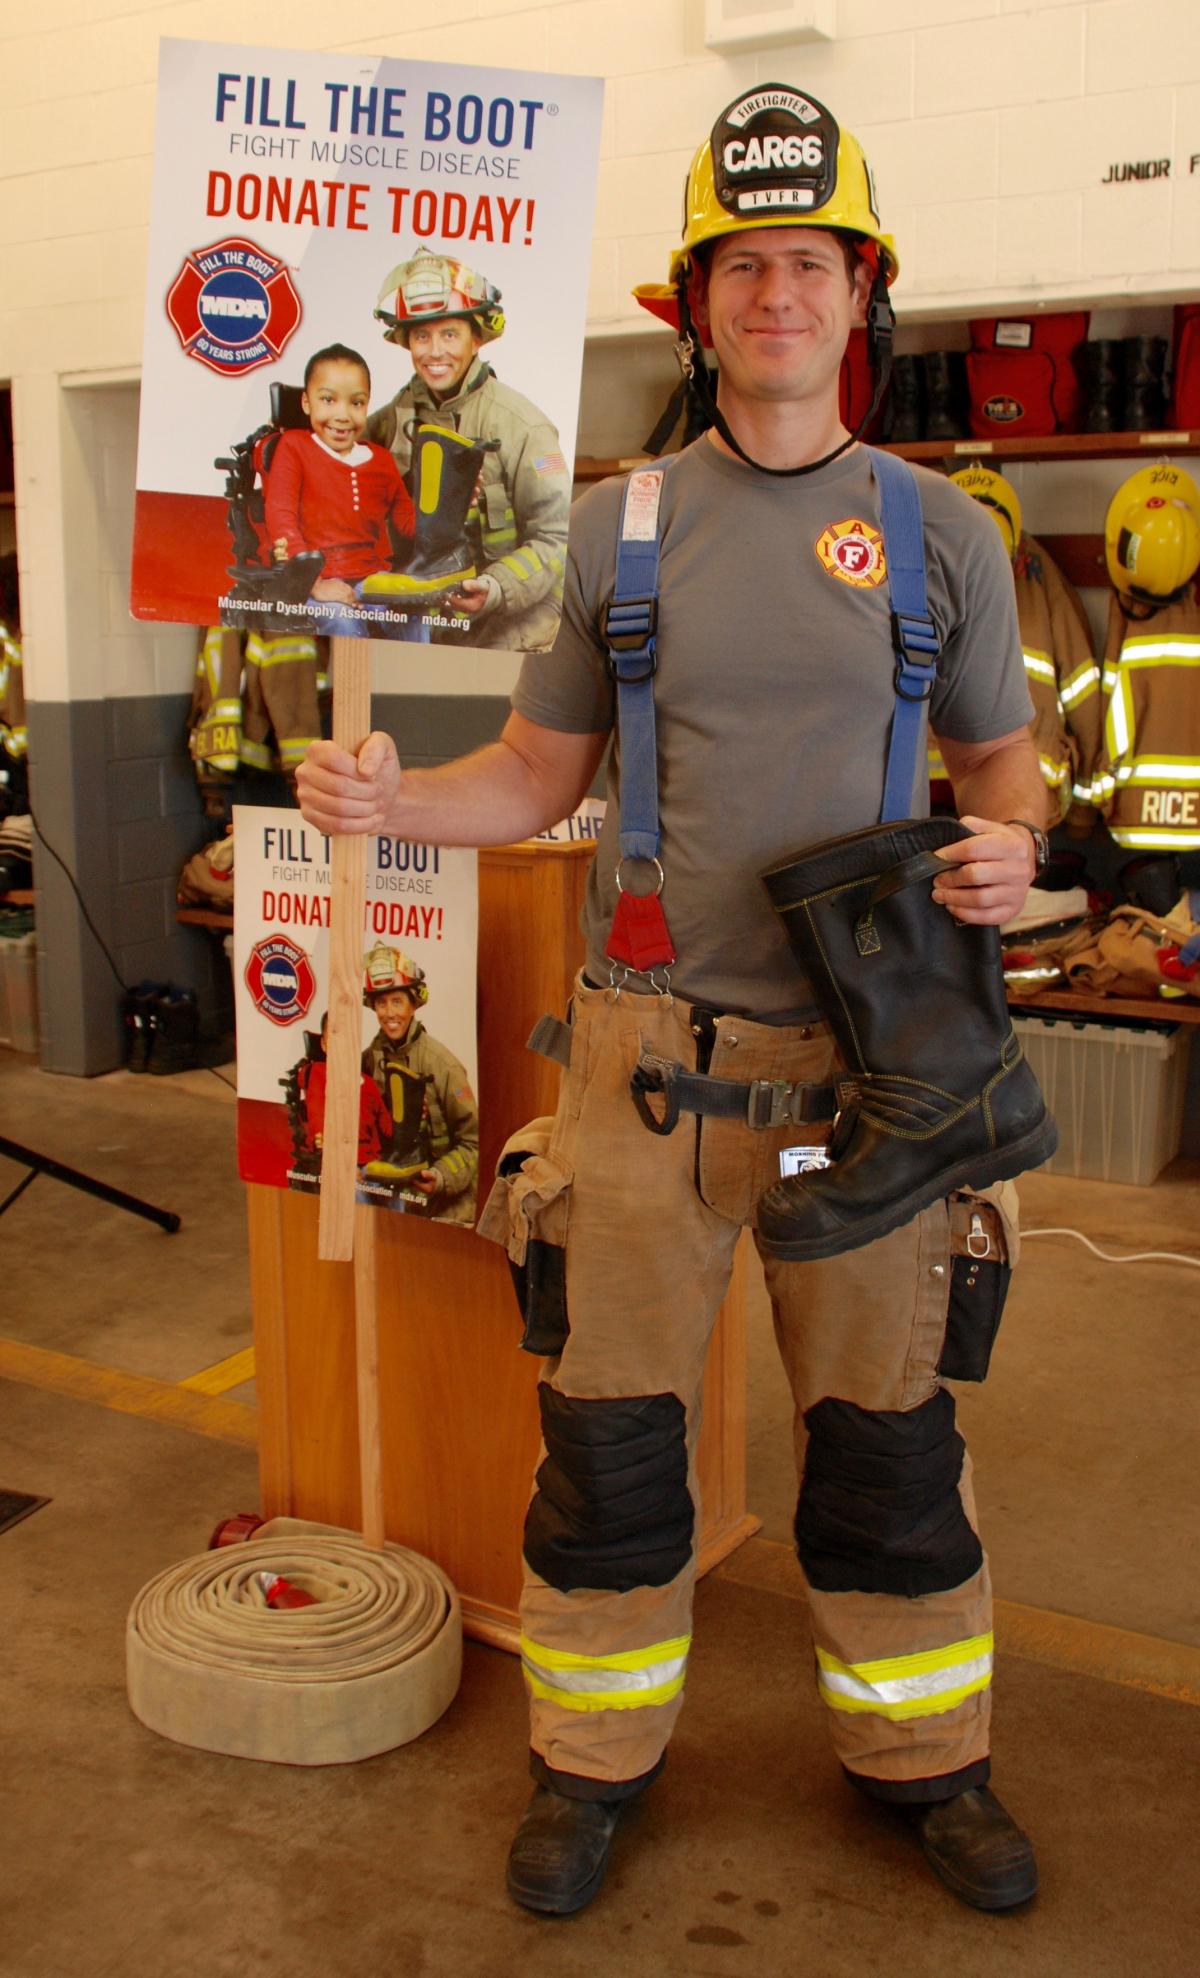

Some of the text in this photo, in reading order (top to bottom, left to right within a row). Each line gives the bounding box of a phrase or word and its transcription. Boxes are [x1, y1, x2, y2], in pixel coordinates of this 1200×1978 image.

[215, 73, 306, 129] FILL
[325, 82, 407, 138] THE
[737, 95, 808, 118] FIREFIGHTER
[229, 133, 520, 179] FIGHT MUSCLE DISEASE
[724, 135, 823, 173] CAR66
[1102, 159, 1171, 183] JUNIOR
[206, 170, 535, 246] DONATE TODAY!
[199, 251, 275, 278] FILL THE BOOT
[208, 345, 234, 360] YEARS
[236, 342, 267, 360] STRONG
[1150, 470, 1179, 486] RICE
[217, 597, 471, 632] Muscular Dystrophy Association mda.org
[1141, 790, 1198, 825] RICE
[263, 827, 312, 863] FILL
[272, 866, 310, 883] FIGHT
[376, 875, 433, 894] DISEASE
[263, 890, 331, 928] DONAT
[286, 1170, 317, 1182] Muscular
[356, 1184, 392, 1197] ssociation
[400, 1192, 427, 1207] mda.org
